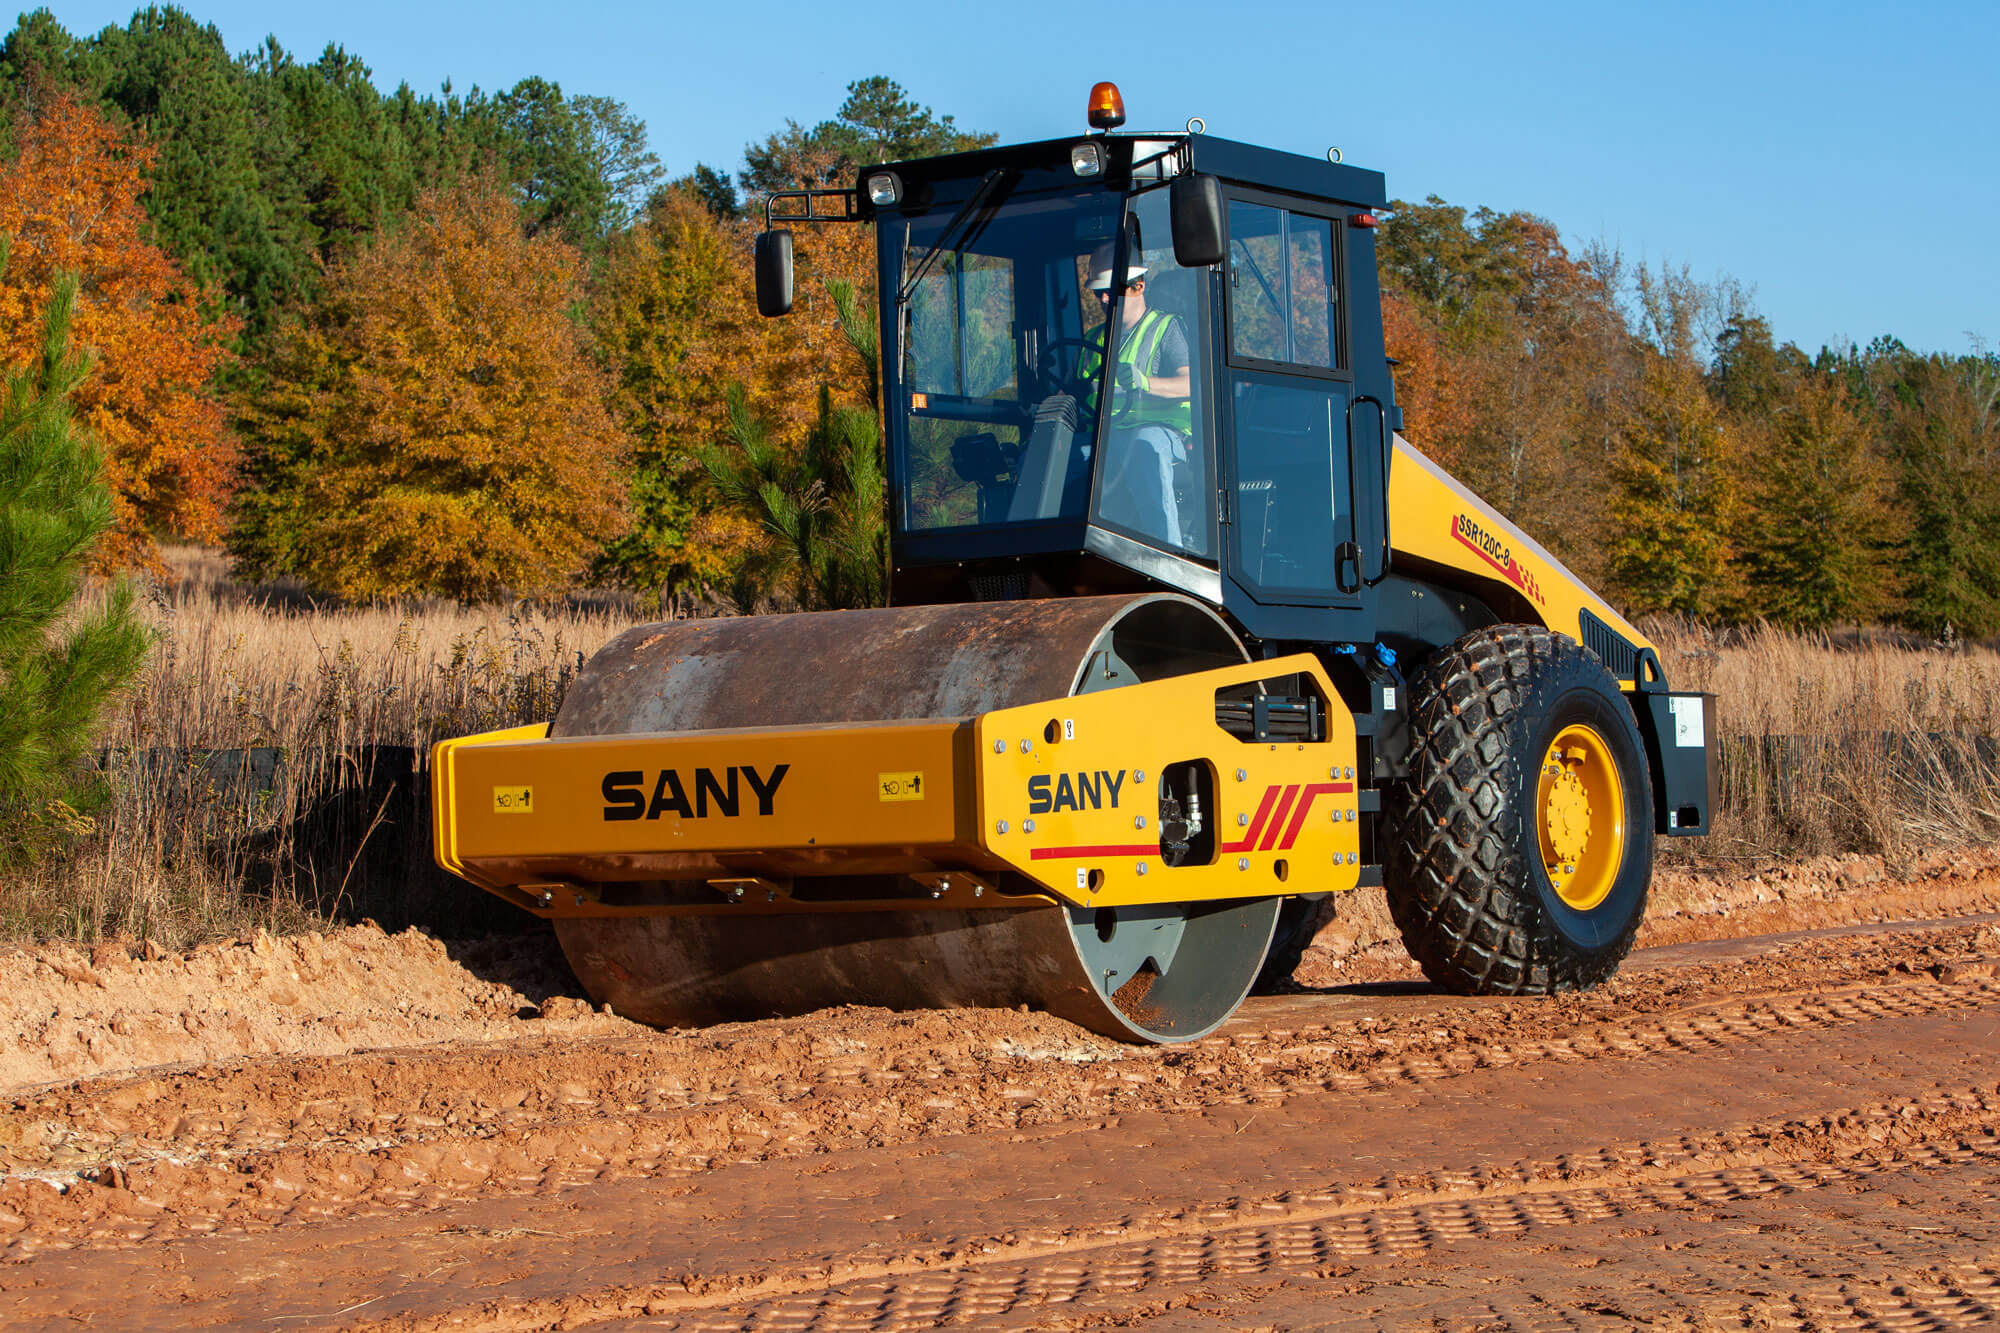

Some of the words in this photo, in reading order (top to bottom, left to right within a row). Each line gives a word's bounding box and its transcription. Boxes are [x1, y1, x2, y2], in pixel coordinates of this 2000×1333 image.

[1458, 513, 1510, 567] SSR120C-8
[601, 764, 791, 822] SANY
[1027, 769, 1126, 815] SANY
